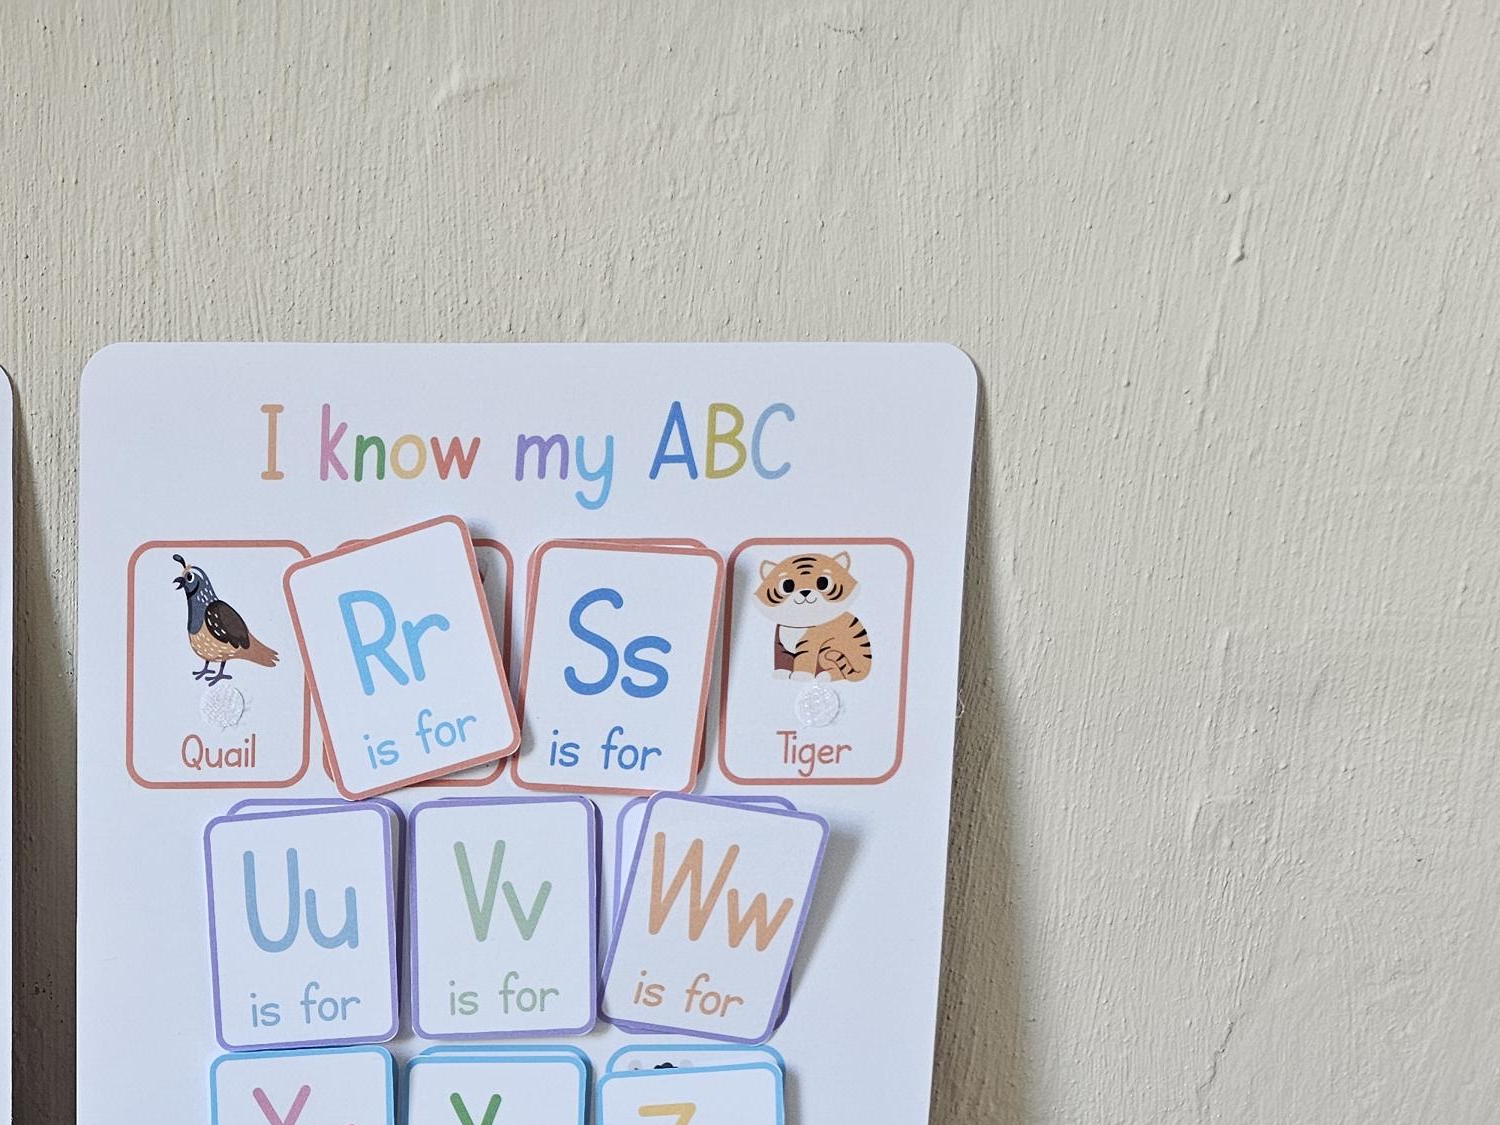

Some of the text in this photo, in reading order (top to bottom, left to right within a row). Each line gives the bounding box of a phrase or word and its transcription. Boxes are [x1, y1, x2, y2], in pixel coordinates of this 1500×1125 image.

[260, 401, 795, 510] I know my ABC
[338, 590, 450, 696] Rr
[564, 588, 671, 698] Ss
[182, 734, 255, 770] Quail
[363, 709, 478, 769] is for
[550, 726, 662, 771] is for
[776, 730, 852, 778] Tiger
[243, 848, 359, 953] Uu
[453, 840, 552, 942] Vv
[648, 831, 793, 952] Ww
[251, 981, 360, 1027] is for
[449, 971, 559, 1016] is for
[634, 970, 744, 1017] is for
